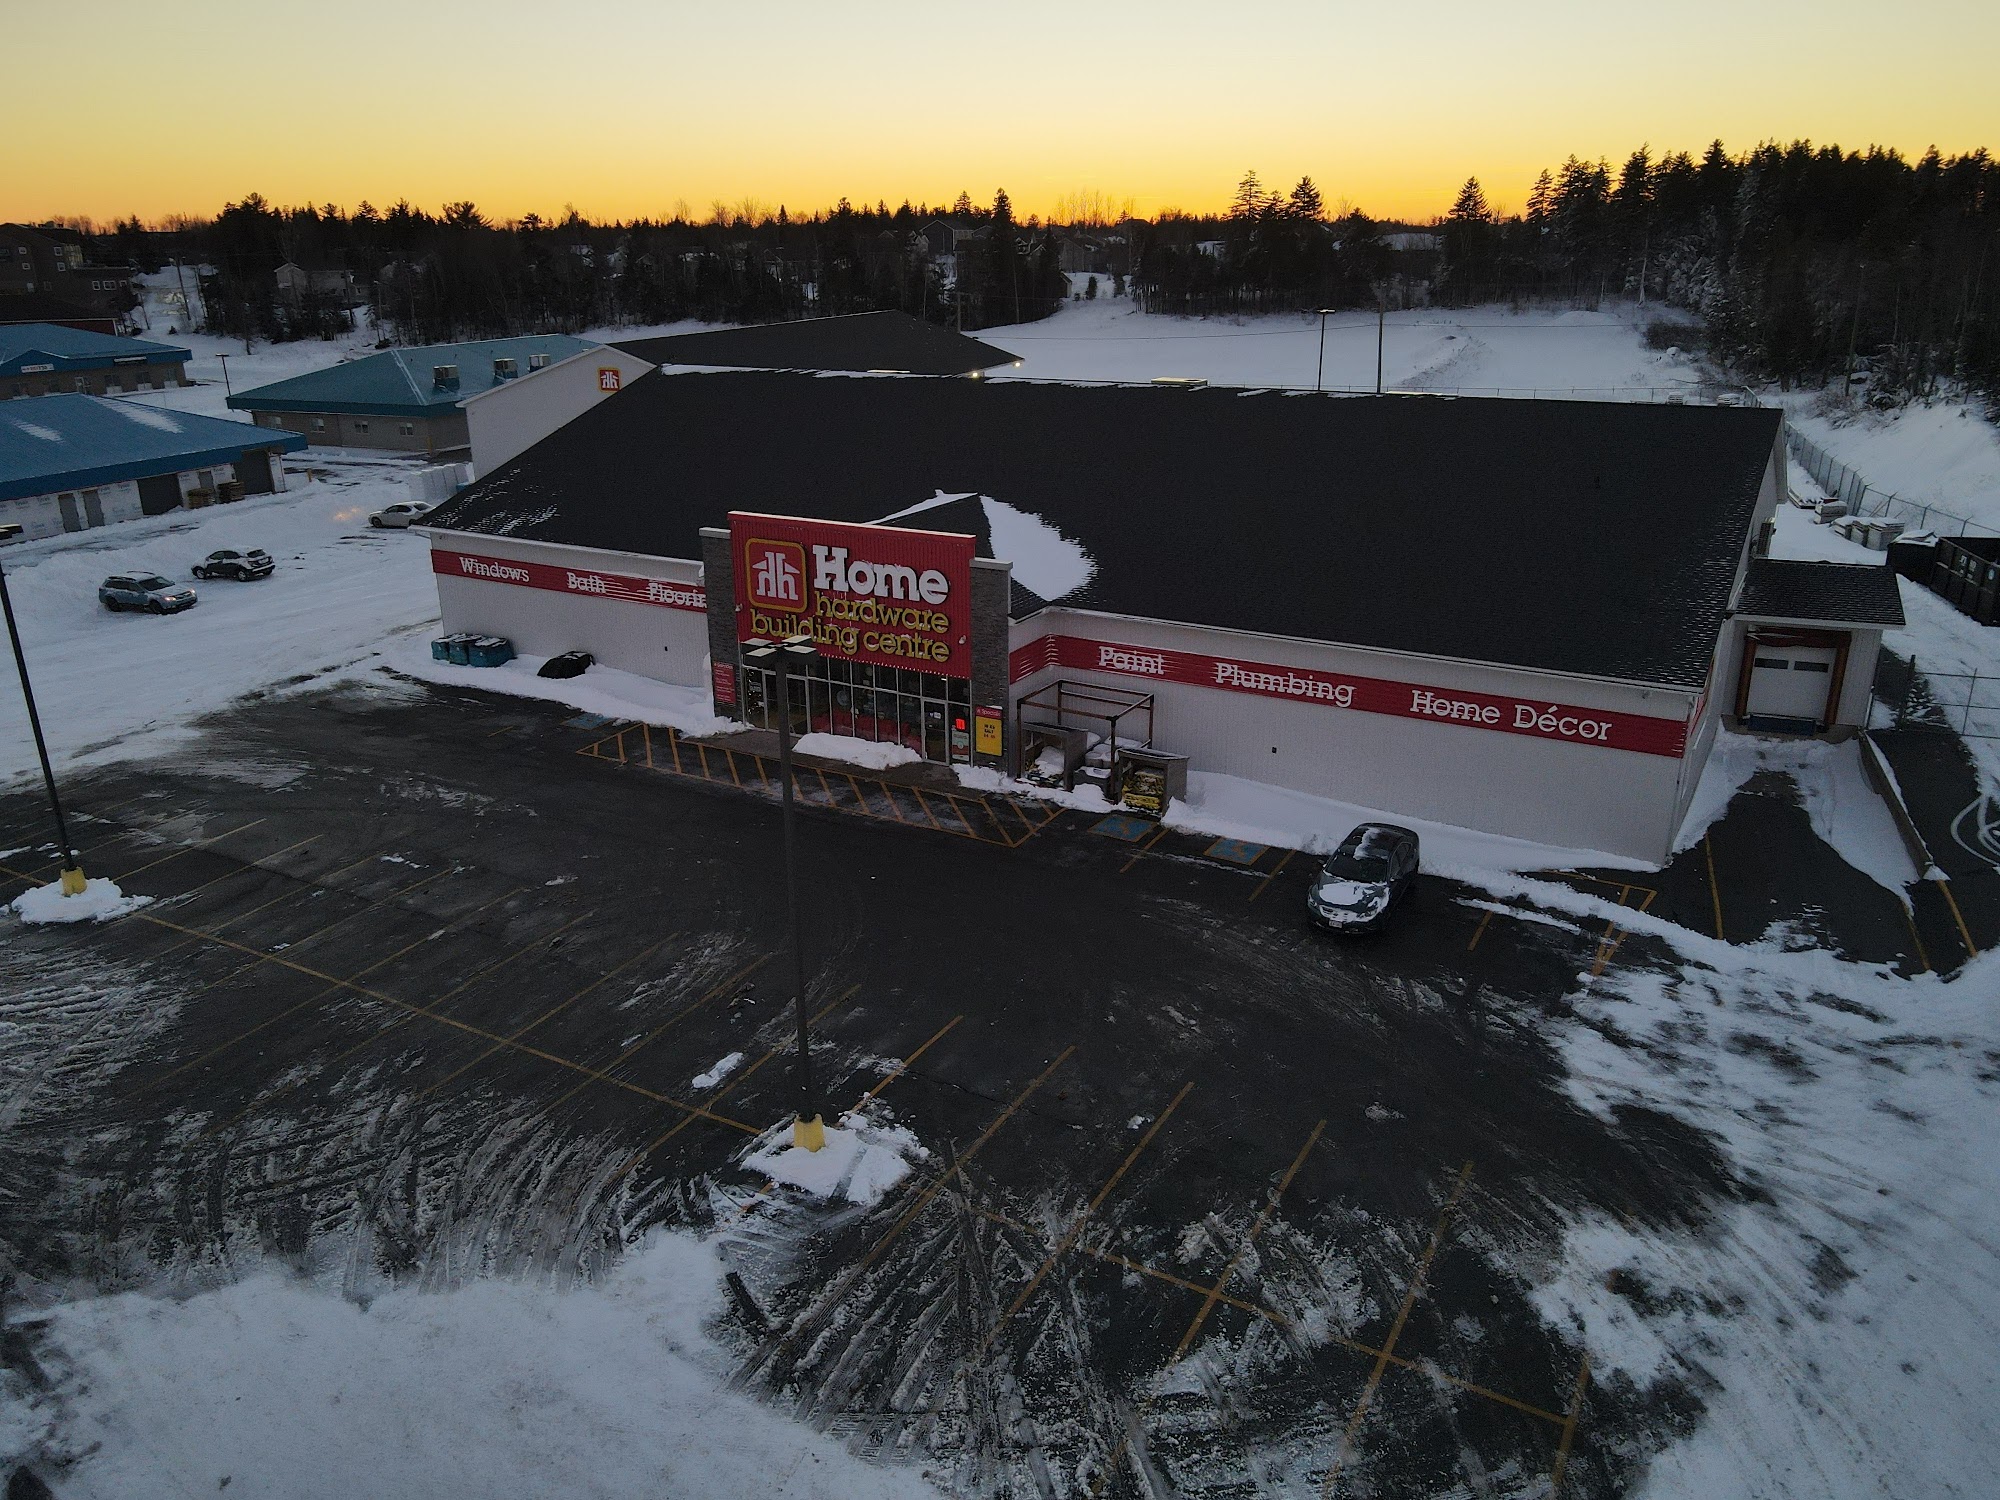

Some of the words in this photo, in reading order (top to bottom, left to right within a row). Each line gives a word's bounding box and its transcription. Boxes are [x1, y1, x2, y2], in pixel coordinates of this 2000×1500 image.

[459, 556, 529, 582] Windows
[567, 572, 607, 594] Bath
[812, 544, 949, 605] Home
[814, 590, 950, 634] hardware
[750, 608, 860, 656] building
[863, 630, 951, 662] centre
[1099, 645, 1164, 675] Paint
[1215, 663, 1355, 708] Plumbing
[1410, 689, 1500, 724] Home
[1513, 705, 1612, 741] Décor
